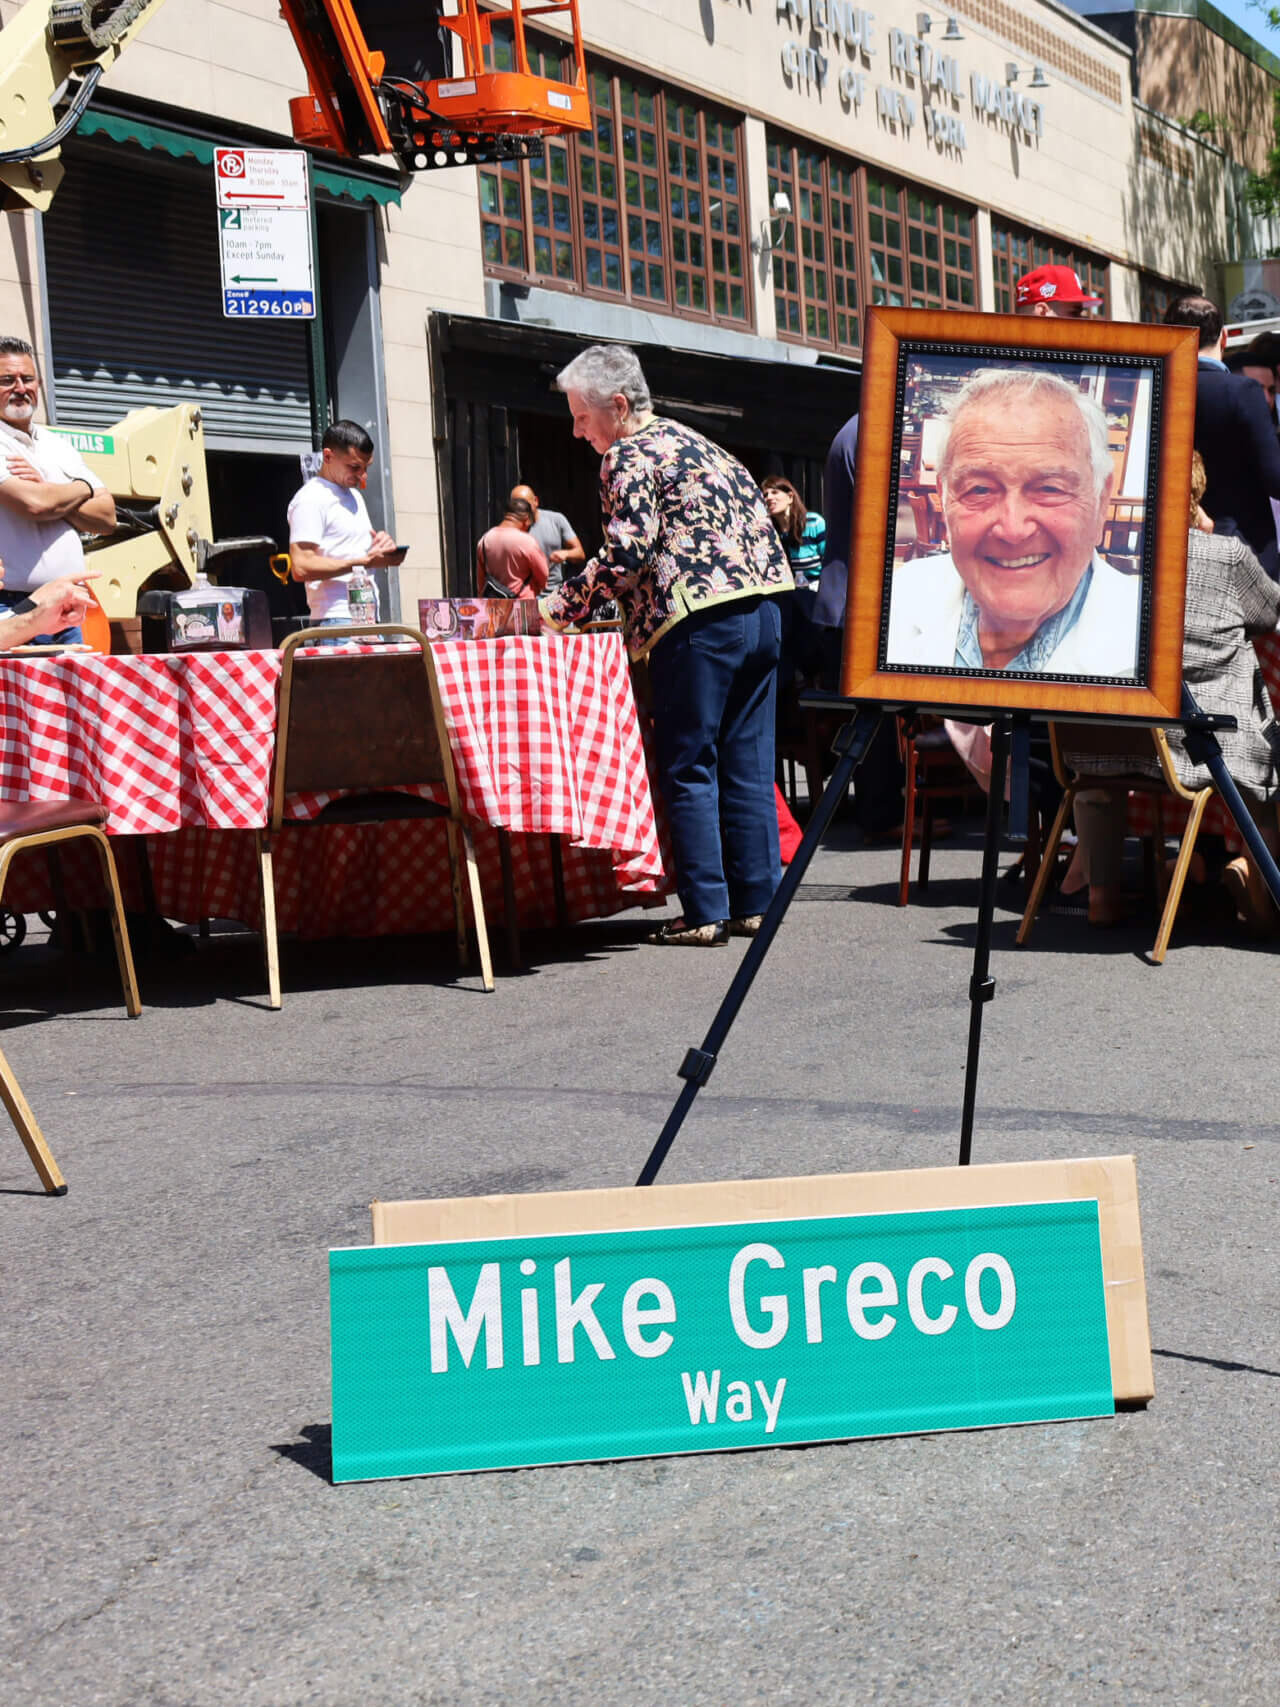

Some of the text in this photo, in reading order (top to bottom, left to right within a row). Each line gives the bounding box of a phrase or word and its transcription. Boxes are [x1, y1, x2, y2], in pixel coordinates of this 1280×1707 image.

[777, 0, 1045, 137] ENUE RETAIL MARKET
[782, 41, 967, 150] CITY OF NEW YORK
[225, 209, 240, 229] 2
[226, 240, 248, 249] 10am
[255, 240, 272, 250] 7pm
[226, 251, 285, 261] Except Sunday
[227, 300, 293, 314] 212960
[428, 1242, 1017, 1374] Mike Greco
[680, 1369, 787, 1434] Way
